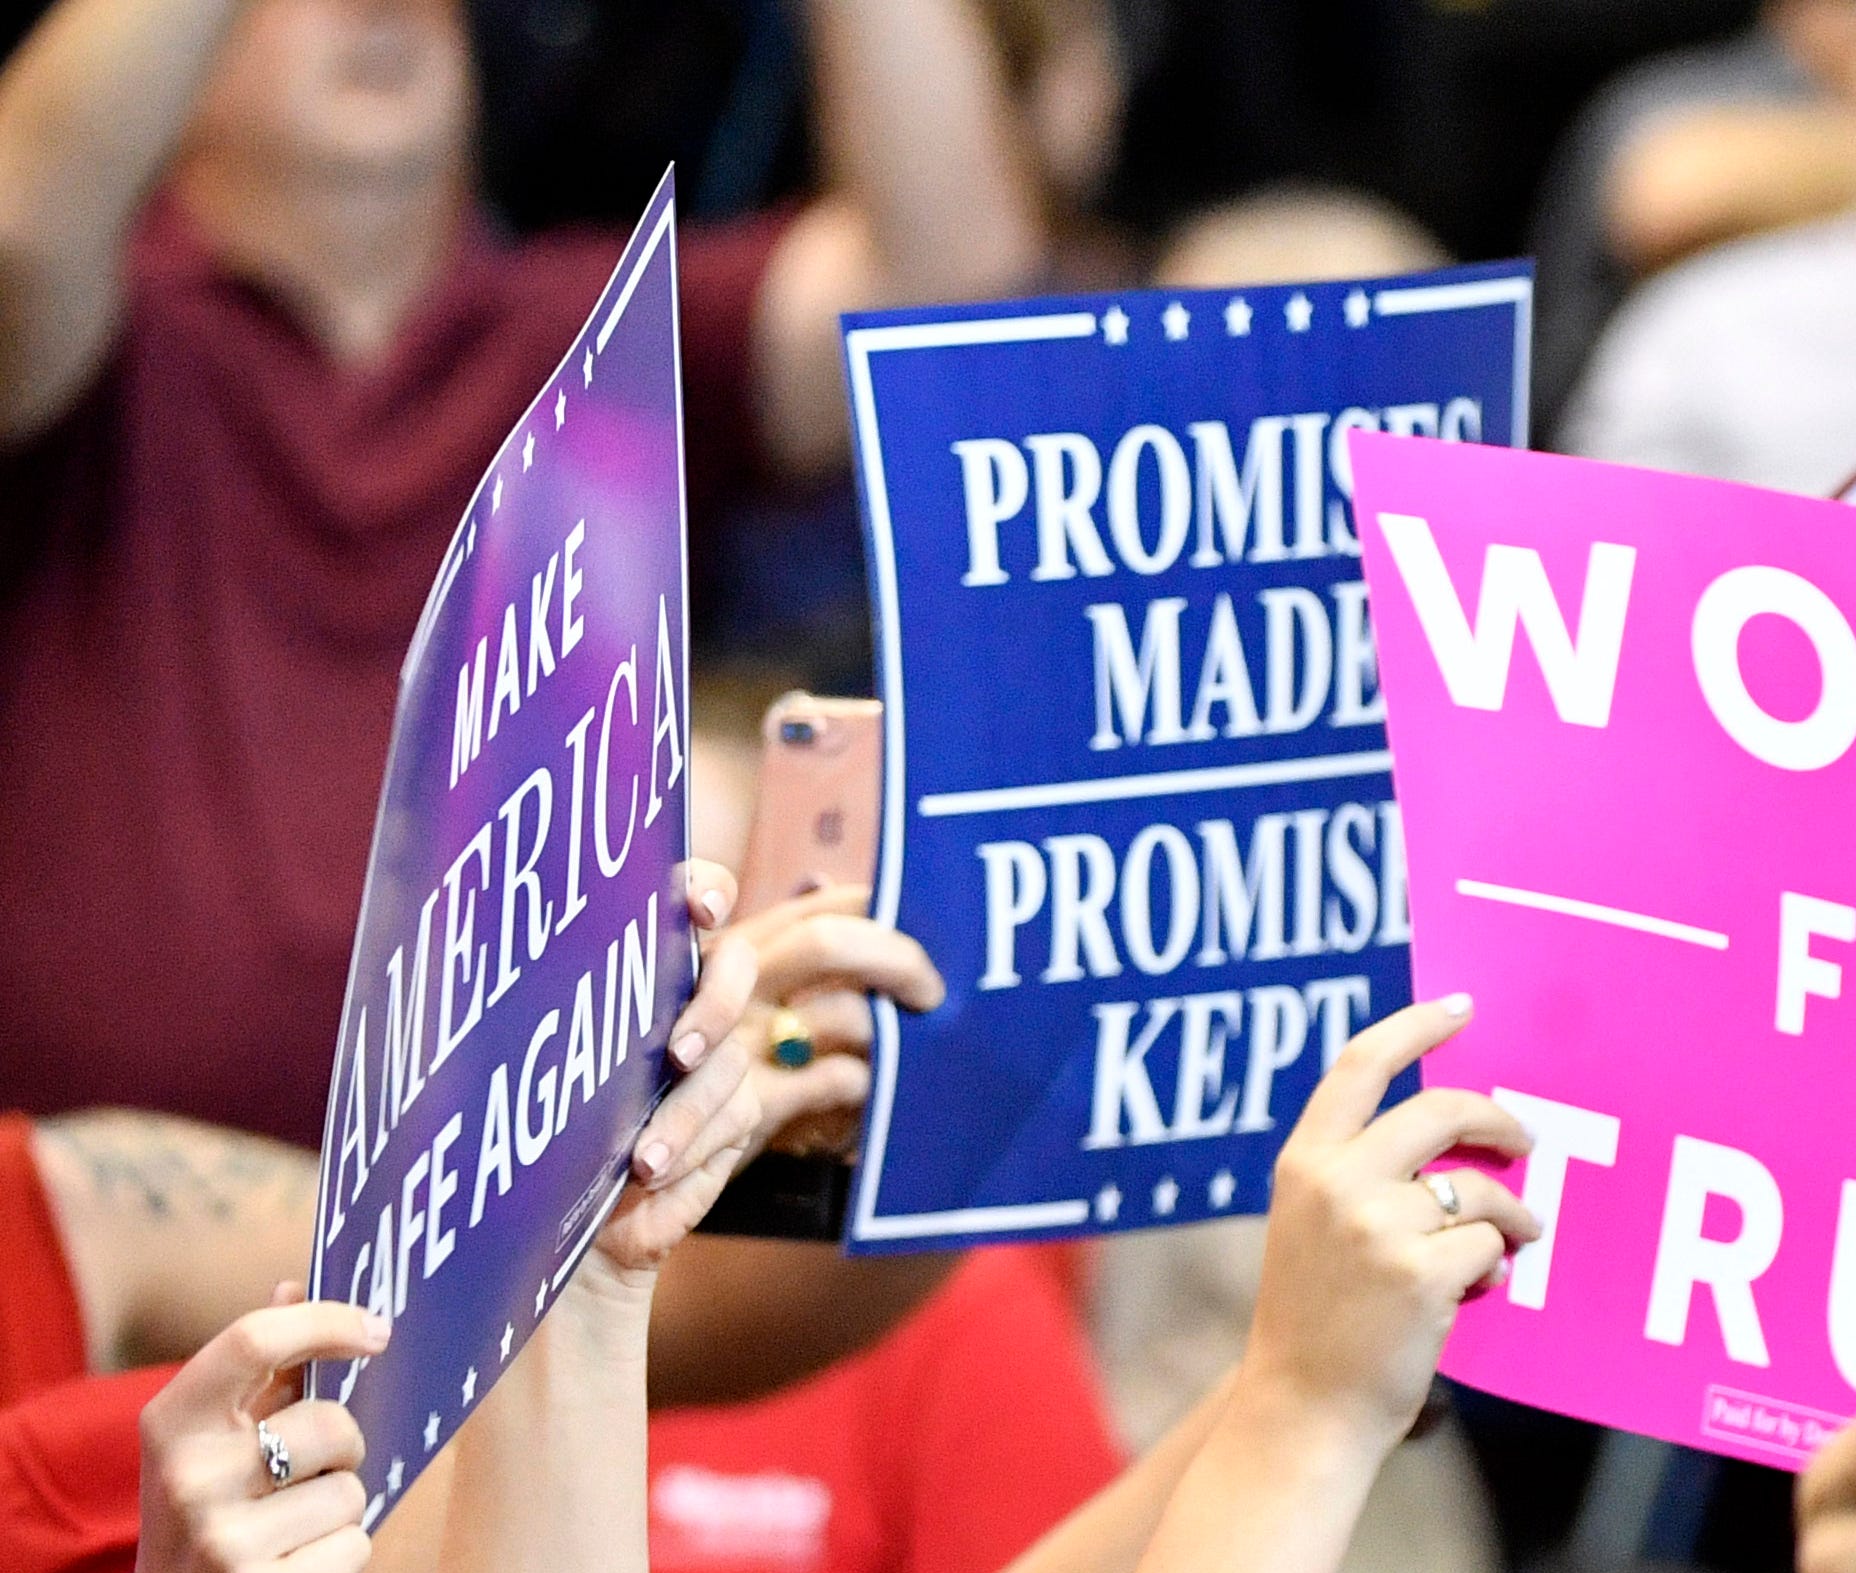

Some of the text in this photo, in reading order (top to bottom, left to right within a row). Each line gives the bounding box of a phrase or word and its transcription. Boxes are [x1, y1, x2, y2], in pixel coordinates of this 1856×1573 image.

[950, 396, 1482, 587] PROMIS
[449, 518, 585, 791] MAKE
[1085, 579, 1384, 751] MADE
[326, 593, 683, 1249] AMERICA
[976, 799, 1414, 991] PROMIS
[339, 892, 658, 1407] SAFE AGAIN
[1083, 974, 1370, 1152] KEPT
